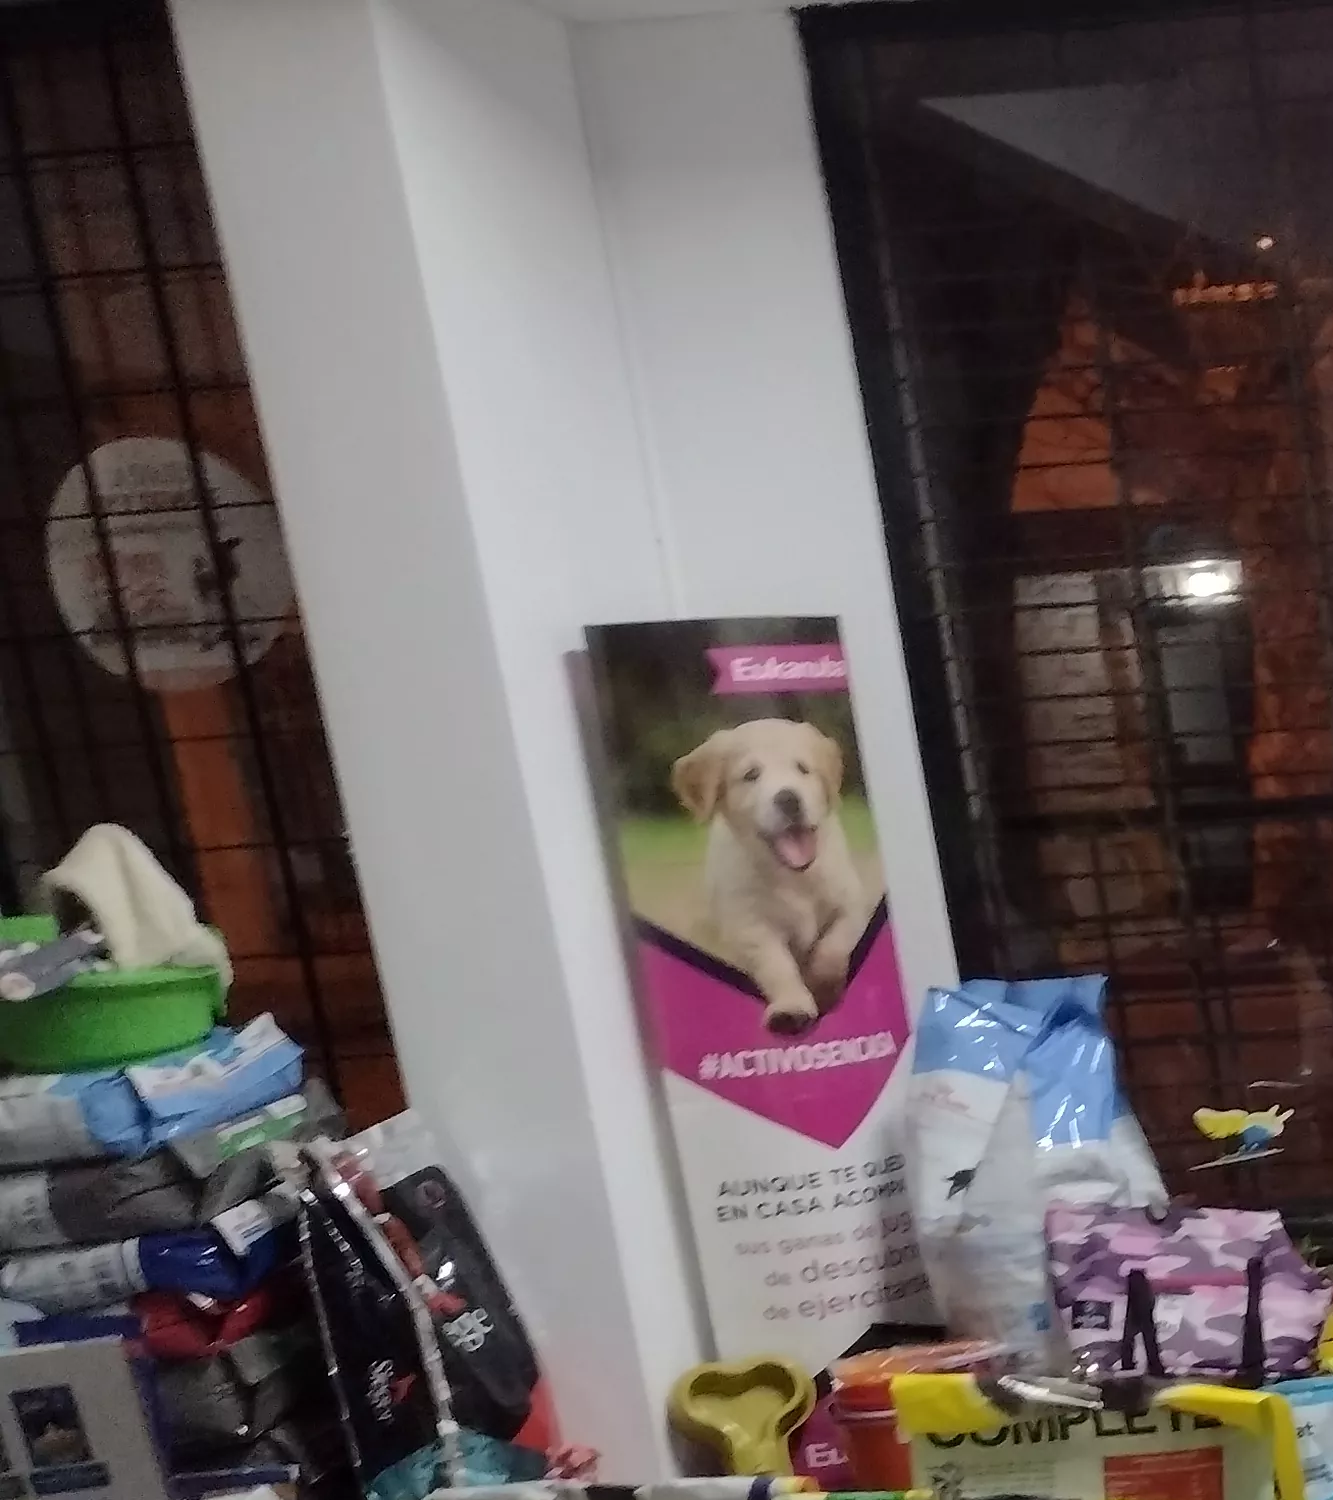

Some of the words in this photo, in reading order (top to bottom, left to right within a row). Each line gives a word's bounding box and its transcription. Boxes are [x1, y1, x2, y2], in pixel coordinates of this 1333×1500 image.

[716, 1171, 823, 1199] AUNQUE
[829, 1165, 857, 1183] TE
[715, 1203, 749, 1223] EN
[755, 1196, 829, 1219] CASA
